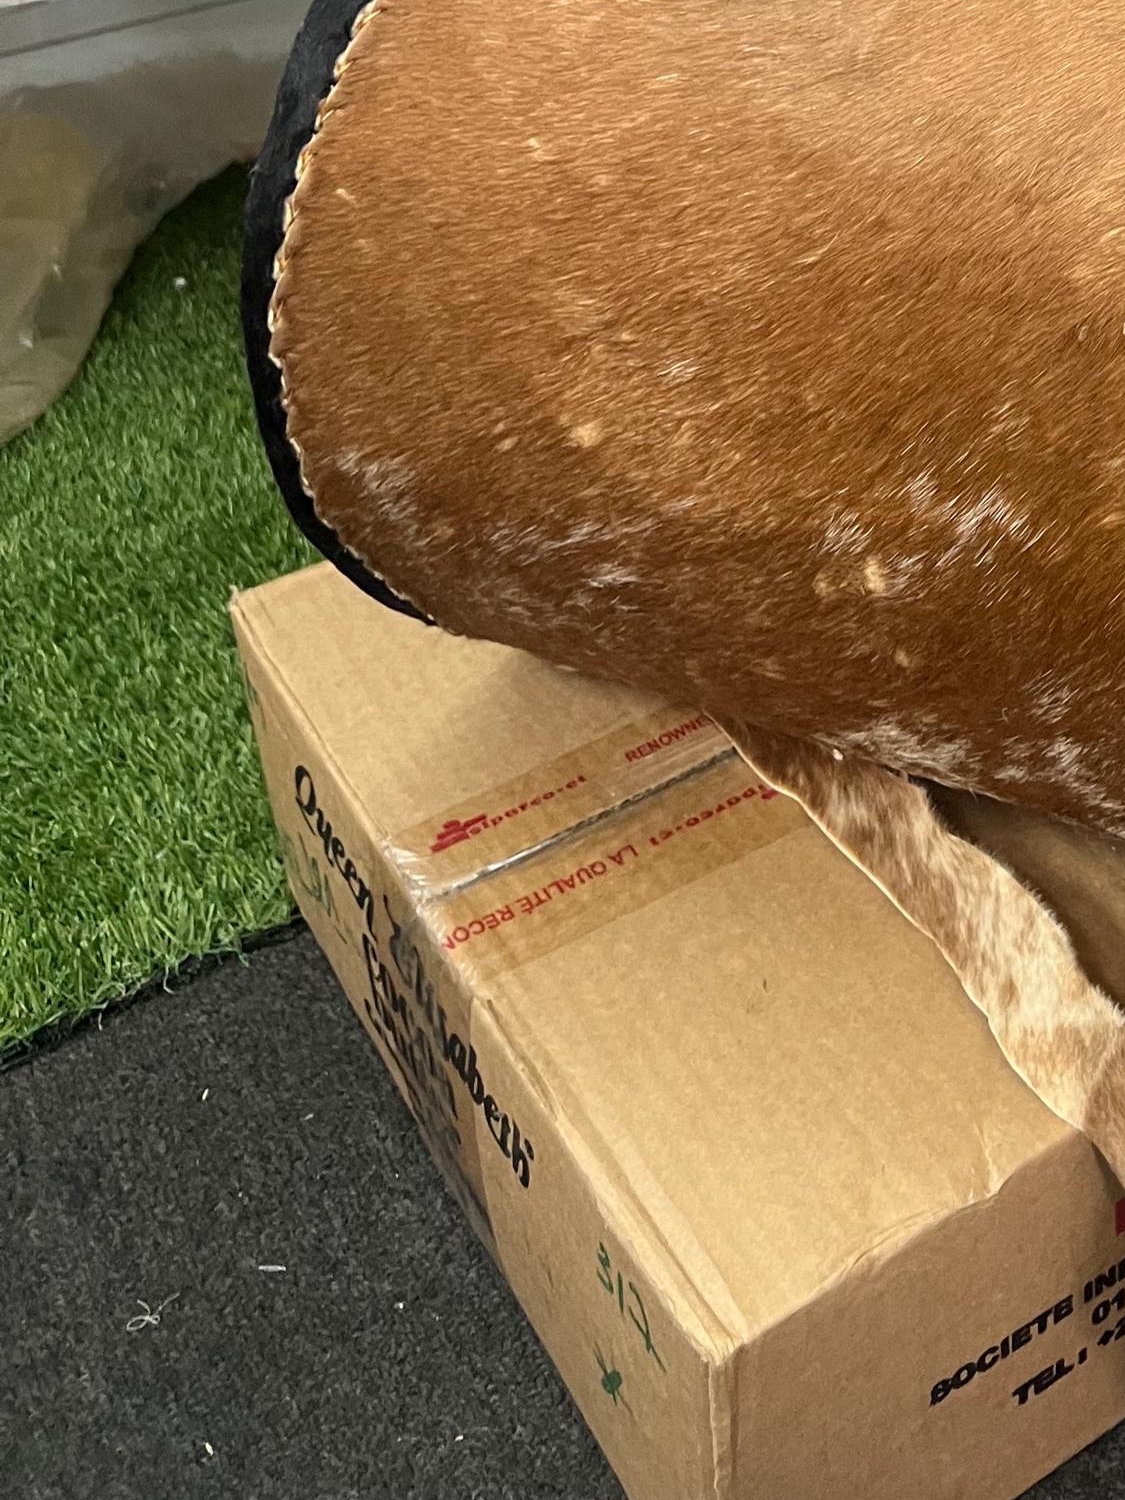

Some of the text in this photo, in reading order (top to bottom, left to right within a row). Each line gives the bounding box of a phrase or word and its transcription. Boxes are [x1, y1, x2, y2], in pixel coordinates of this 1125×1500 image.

[294, 764, 378, 943] Queen
[608, 844, 639, 869] LA
[518, 861, 608, 916] QUALITÉ
[1091, 1287, 1125, 1326] 01
